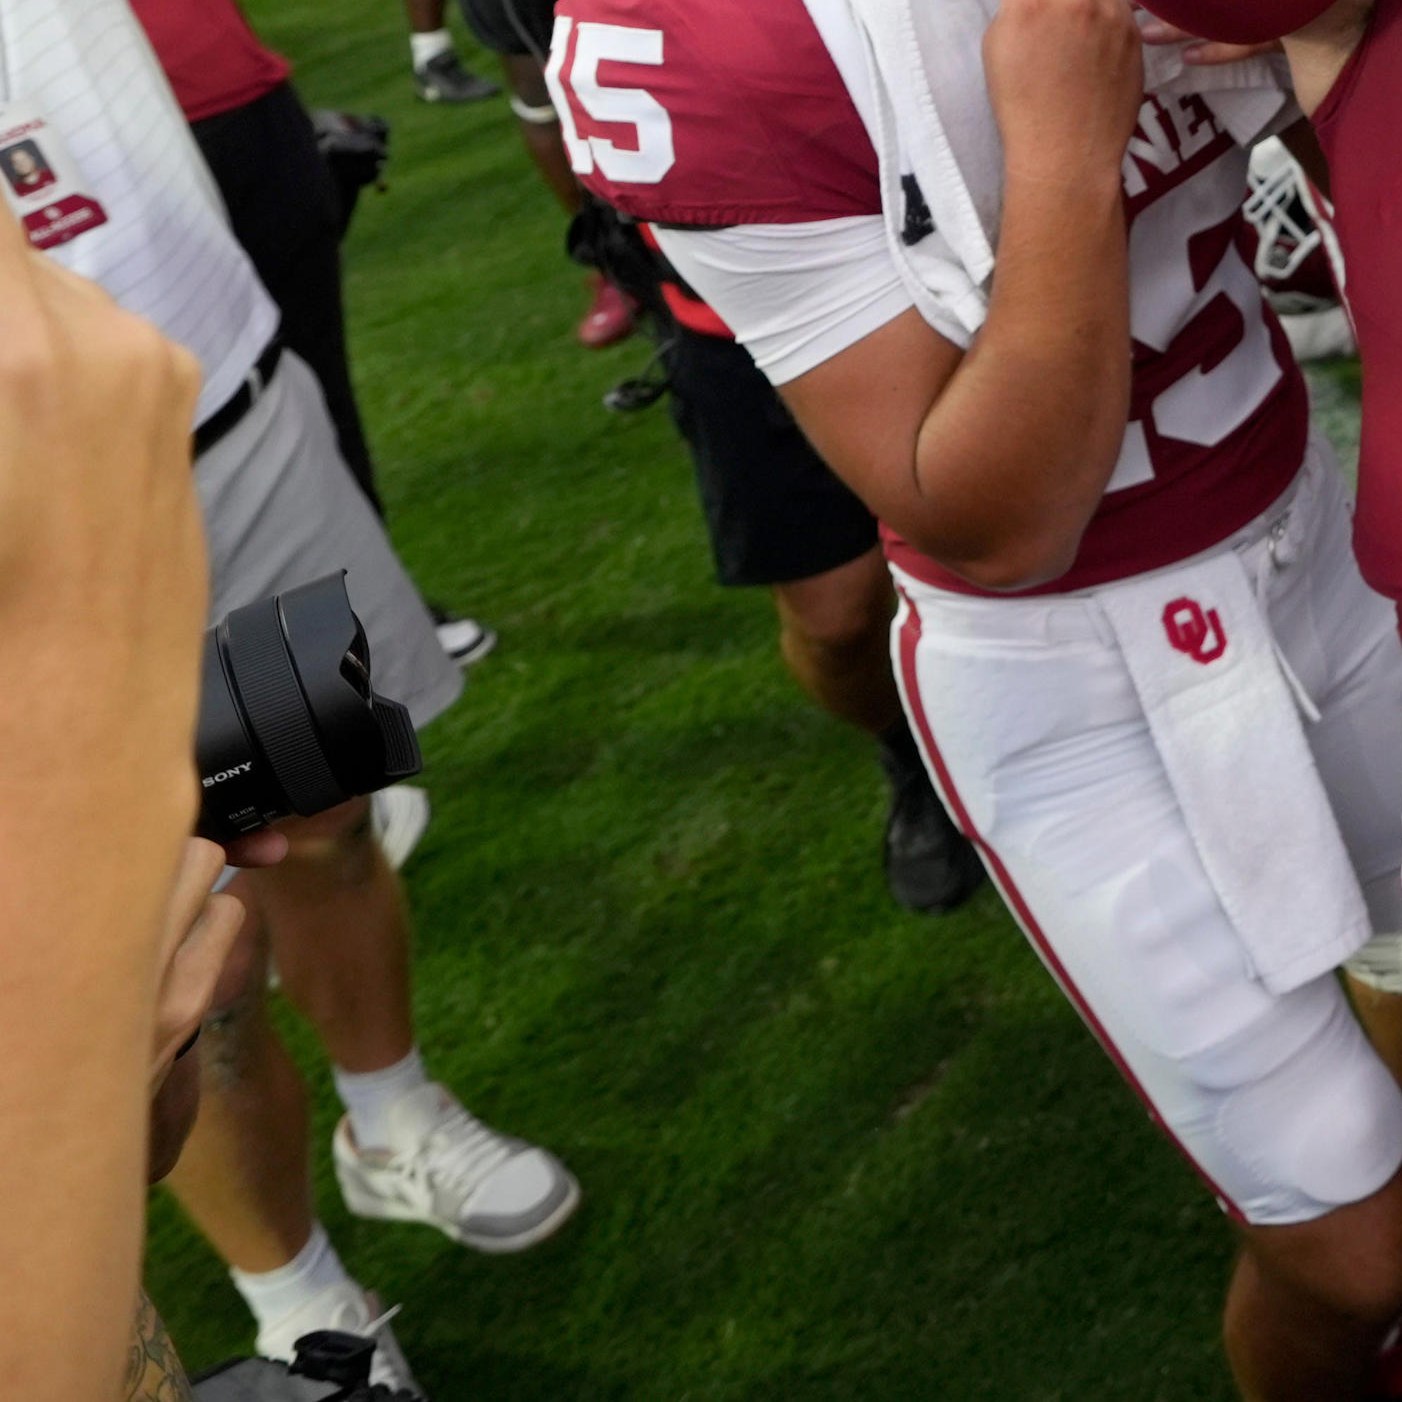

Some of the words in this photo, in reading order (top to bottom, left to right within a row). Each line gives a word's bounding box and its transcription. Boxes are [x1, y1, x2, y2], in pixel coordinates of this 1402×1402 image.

[545, 16, 675, 184] 15
[1161, 596, 1227, 665] OU
[202, 761, 252, 788] SONY
